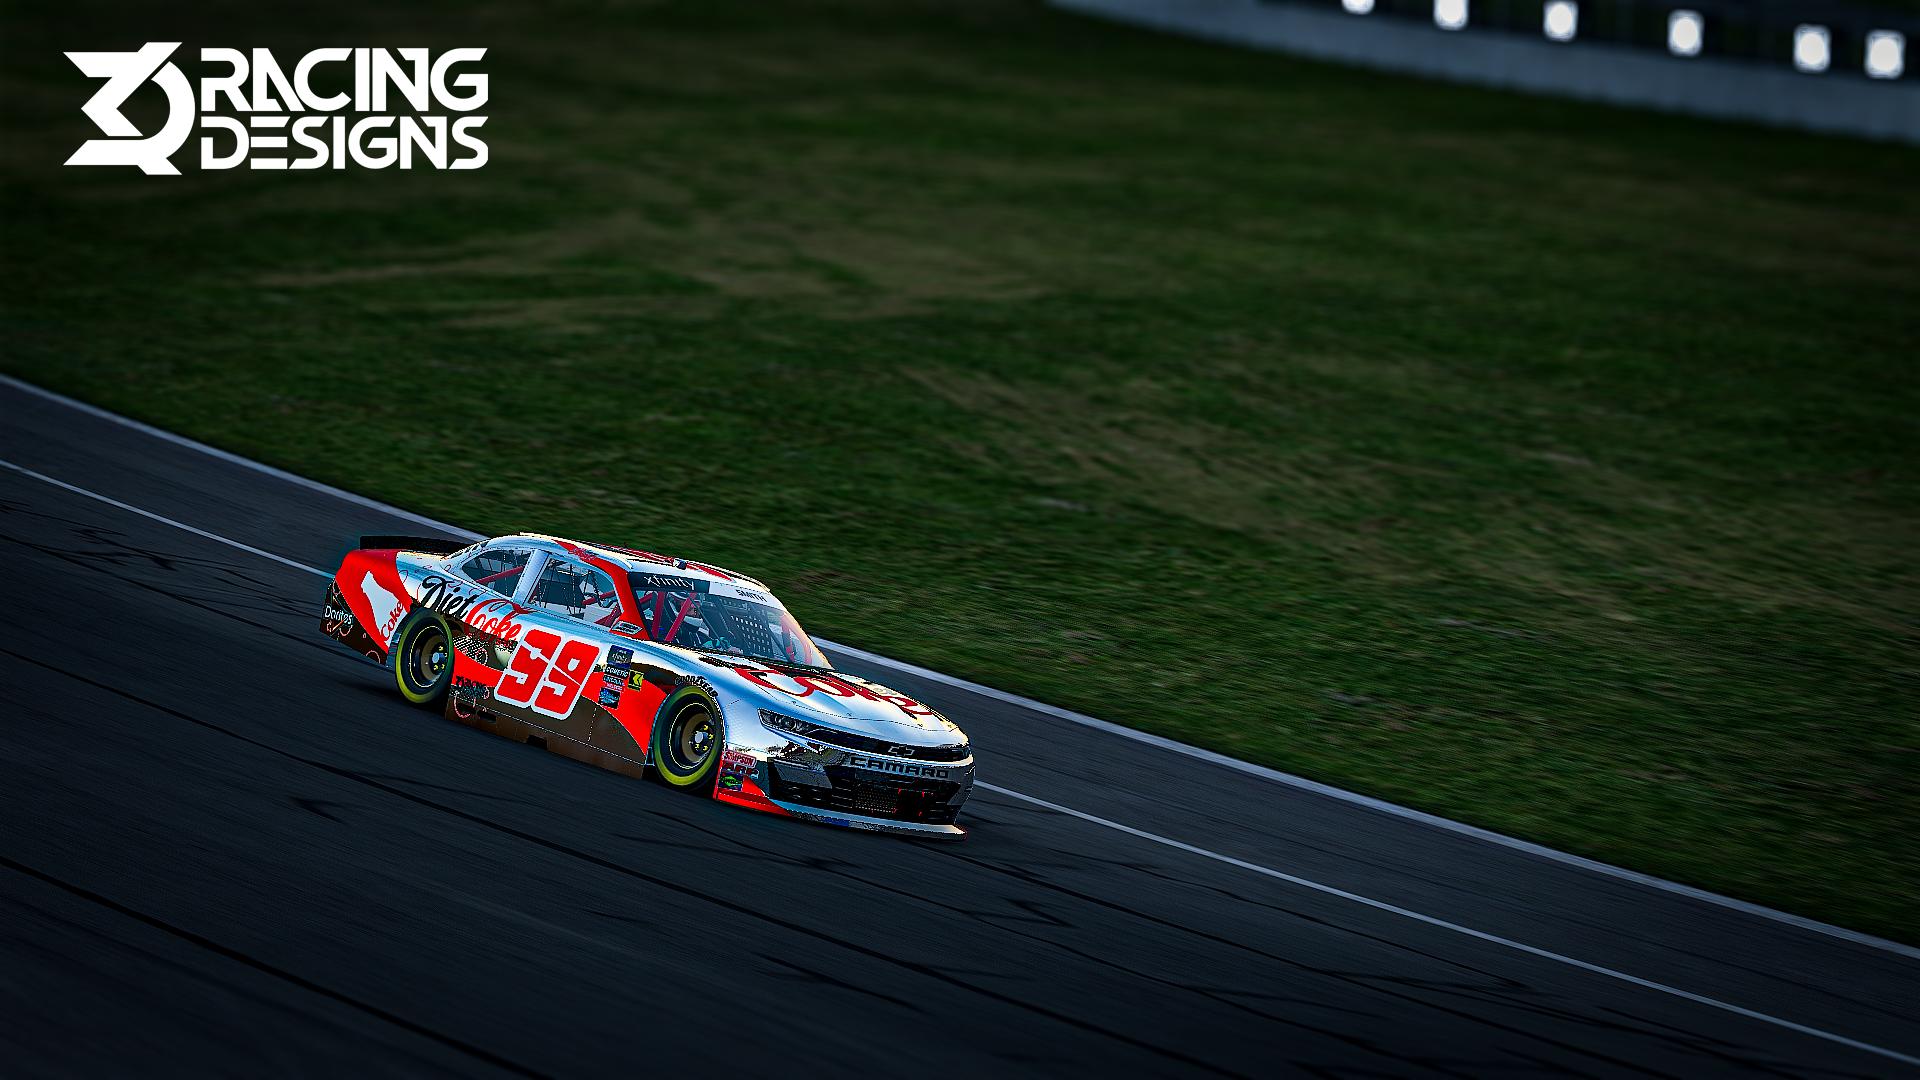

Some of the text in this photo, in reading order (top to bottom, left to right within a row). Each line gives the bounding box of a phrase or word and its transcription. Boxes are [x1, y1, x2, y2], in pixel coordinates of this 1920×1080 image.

[644, 575, 695, 591] xfinity
[736, 589, 768, 602] SMITH
[324, 605, 353, 625] Doritos
[421, 575, 531, 641] Diet Coke
[381, 601, 404, 641] Coke
[849, 755, 949, 779] CAMARO
